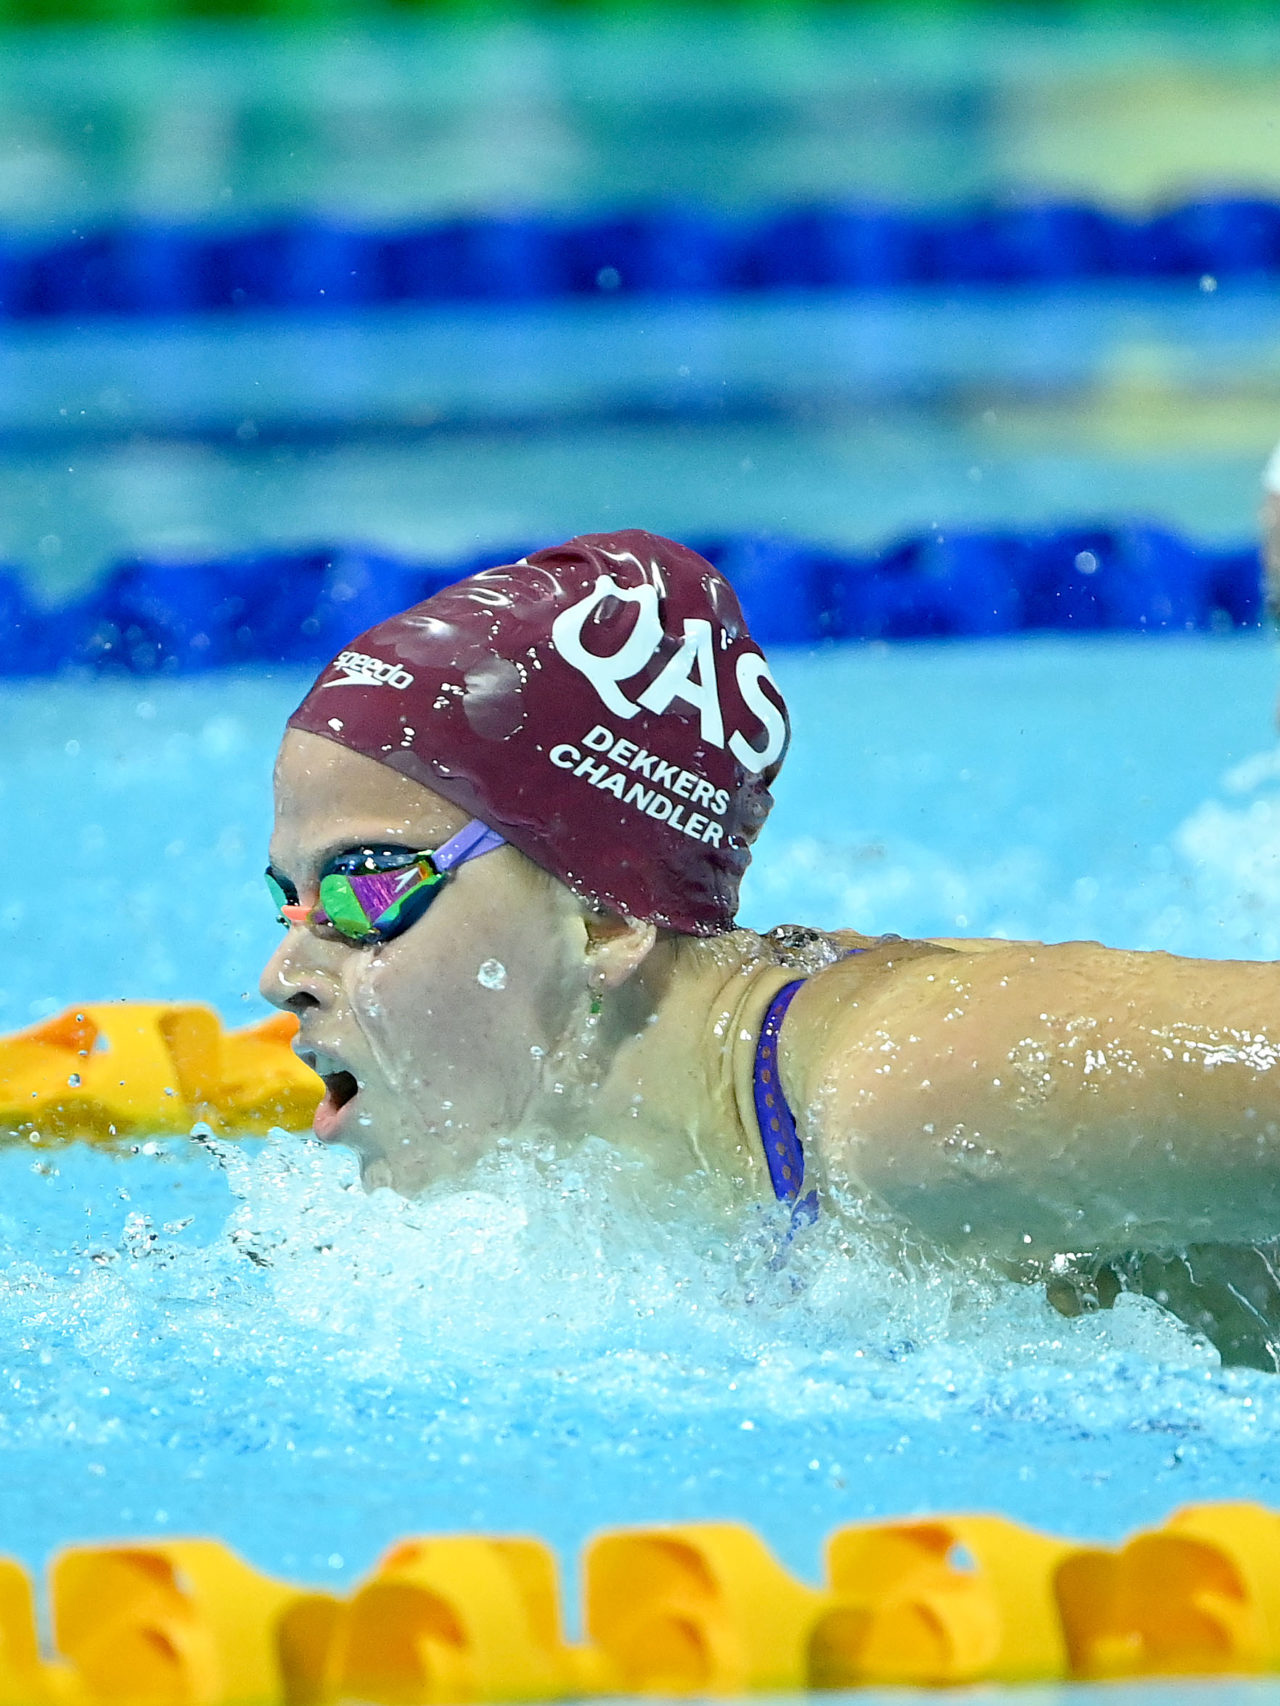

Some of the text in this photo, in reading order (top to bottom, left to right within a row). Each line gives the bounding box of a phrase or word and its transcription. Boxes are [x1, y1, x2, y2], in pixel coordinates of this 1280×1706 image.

[333, 651, 415, 690] speedo
[552, 575, 786, 773] QAS
[549, 744, 724, 849] CHANDLER
[581, 725, 730, 815] DEKKERS
